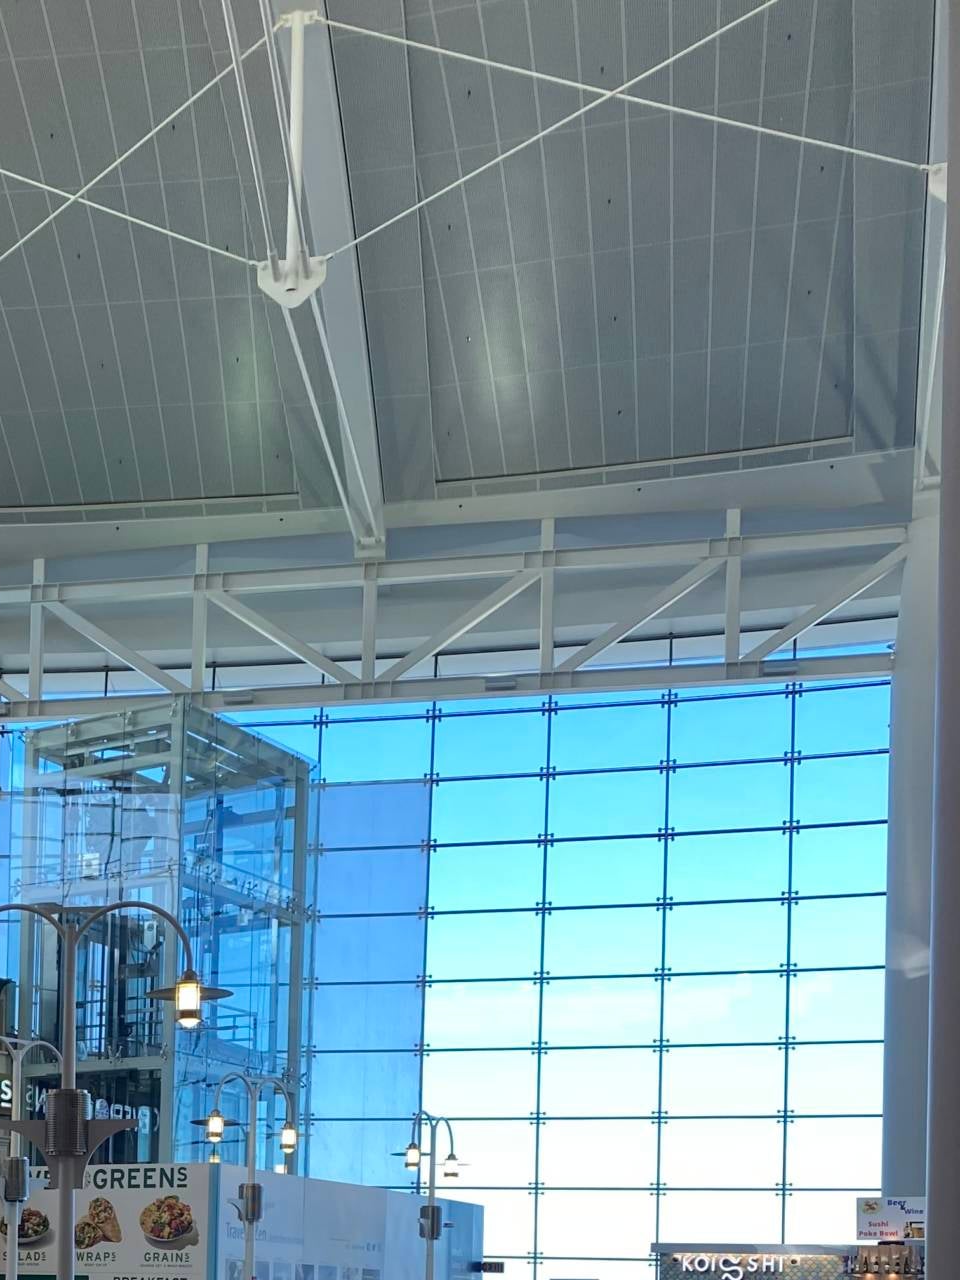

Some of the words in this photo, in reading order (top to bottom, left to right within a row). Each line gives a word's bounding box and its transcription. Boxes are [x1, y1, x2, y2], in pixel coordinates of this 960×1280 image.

[93, 1166, 187, 1189] GREENS
[3, 1251, 46, 1261] SLADS
[76, 1251, 116, 1262] WRAPS
[144, 1252, 189, 1263] GRAINS
